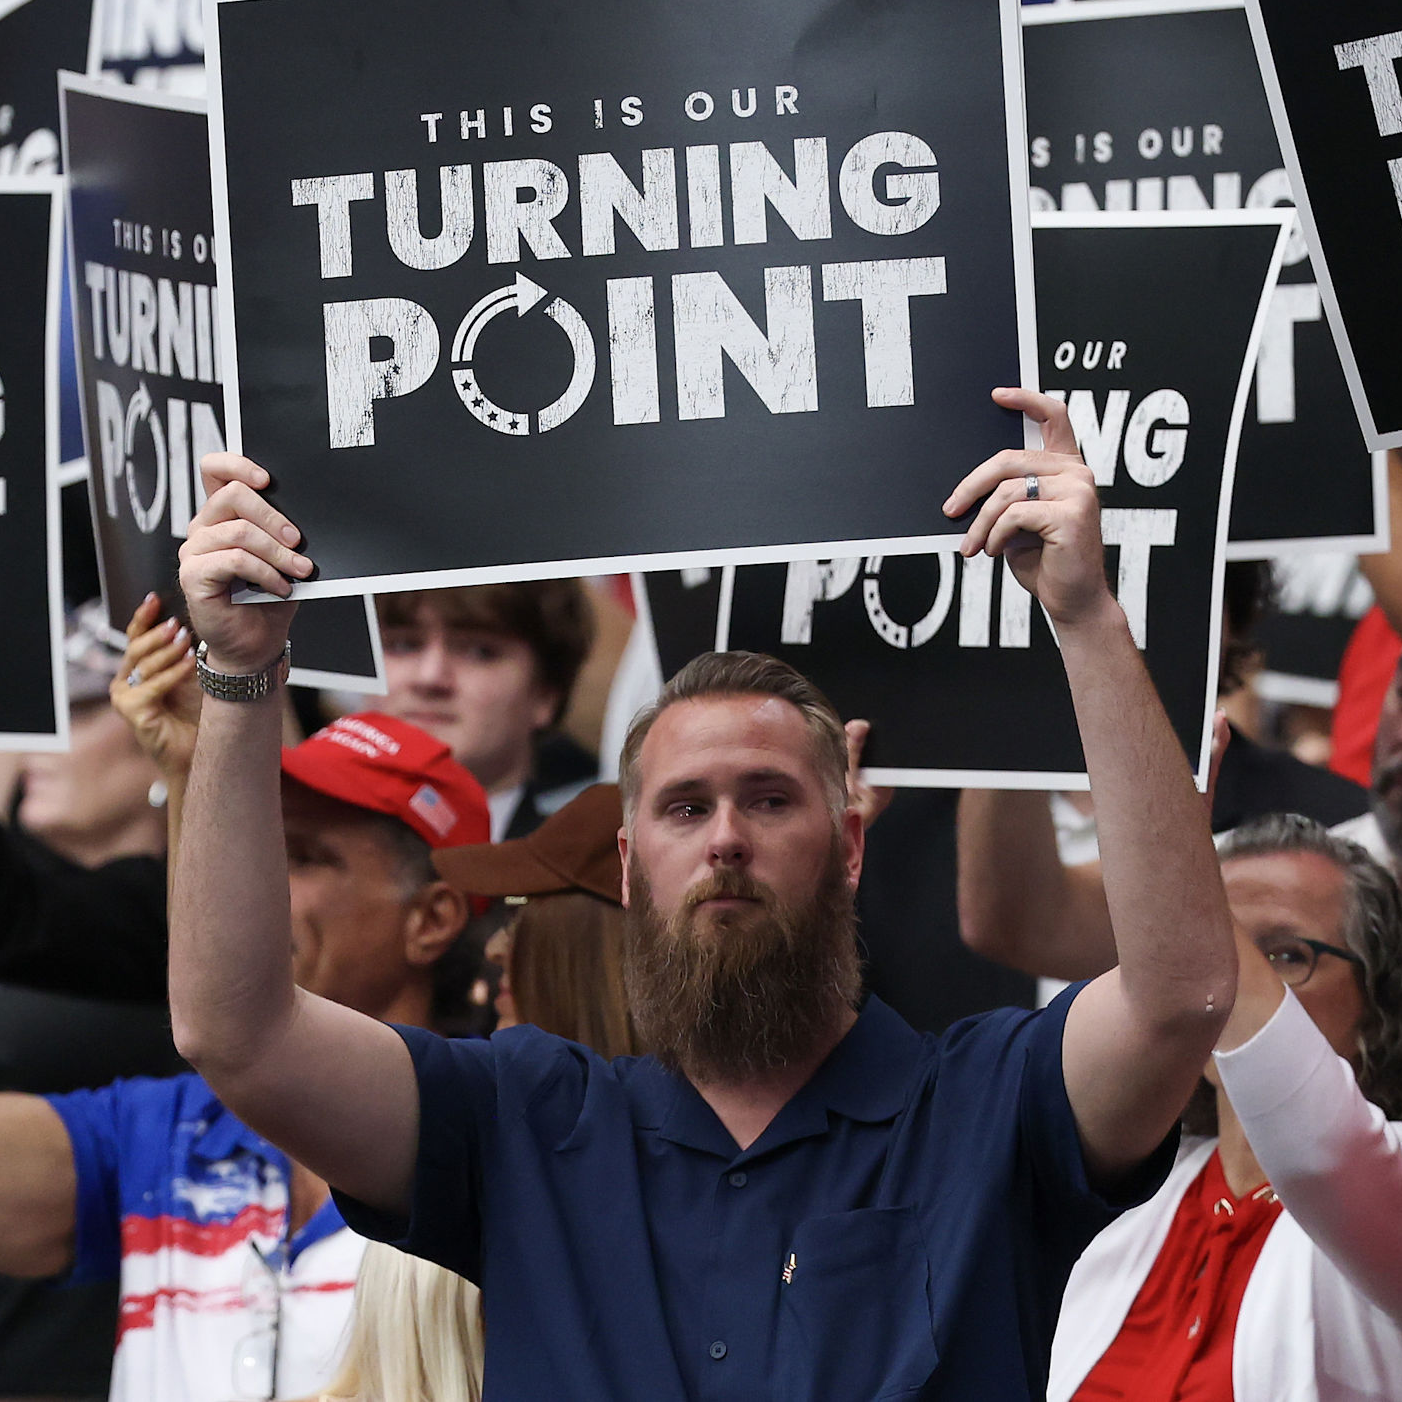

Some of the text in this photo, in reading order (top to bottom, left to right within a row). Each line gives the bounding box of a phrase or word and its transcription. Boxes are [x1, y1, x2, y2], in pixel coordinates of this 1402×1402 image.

[421, 85, 802, 144] THIS IS OUR
[1074, 124, 1225, 164] IS OUR
[291, 131, 942, 280] TURNING
[113, 218, 153, 255] THIS
[162, 229, 182, 260] IS
[85, 260, 224, 385] TURNI
[322, 257, 948, 450] POINT
[1054, 341, 1128, 371] OUR
